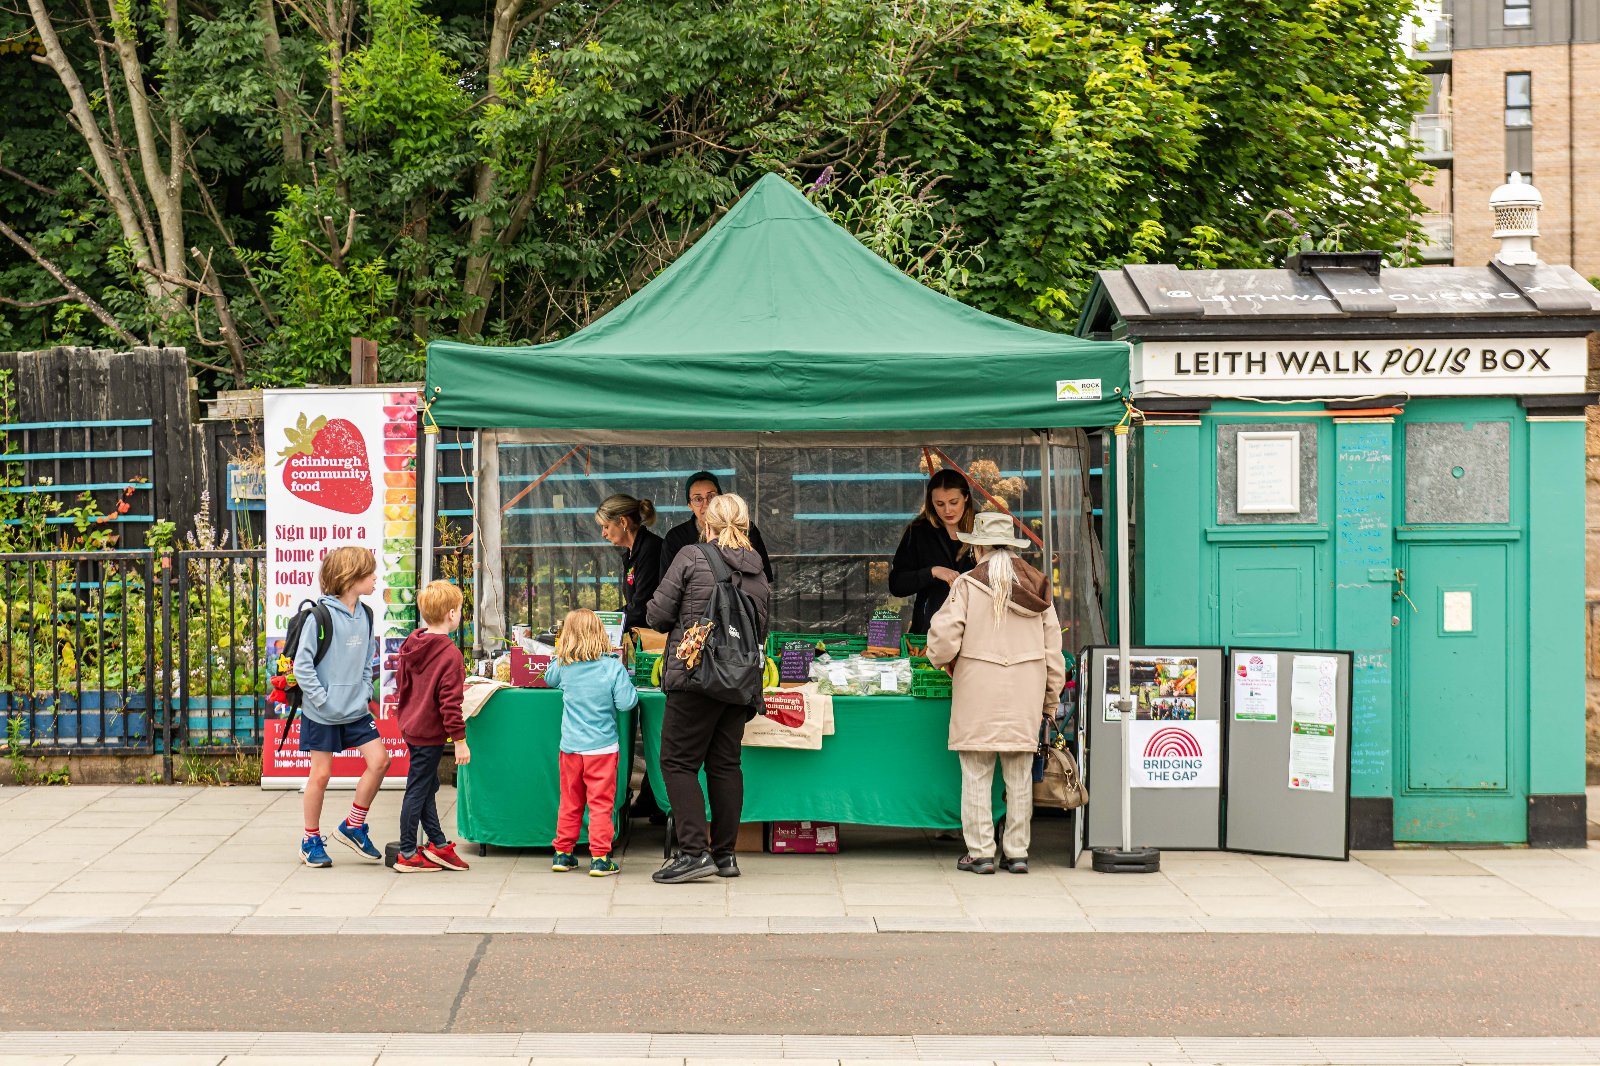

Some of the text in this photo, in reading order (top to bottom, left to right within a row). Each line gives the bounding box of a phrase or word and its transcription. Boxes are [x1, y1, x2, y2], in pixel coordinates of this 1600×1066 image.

[1175, 347, 1551, 376] LEITH WALK POLIS BOX
[291, 455, 363, 469] edinburgh
[291, 468, 369, 481] community
[252, 484, 265, 496] GR
[290, 481, 321, 492] food
[275, 524, 366, 542] Sign up for a
[275, 547, 315, 562] home
[275, 569, 315, 587] today
[275, 591, 292, 608] Or
[275, 614, 290, 630] Co
[764, 696, 801, 705] edinburgh
[765, 704, 803, 713] ommunity
[274, 723, 282, 734] T:
[1143, 759, 1203, 769] BRIDGING
[1147, 771, 1198, 781] THE GAP
